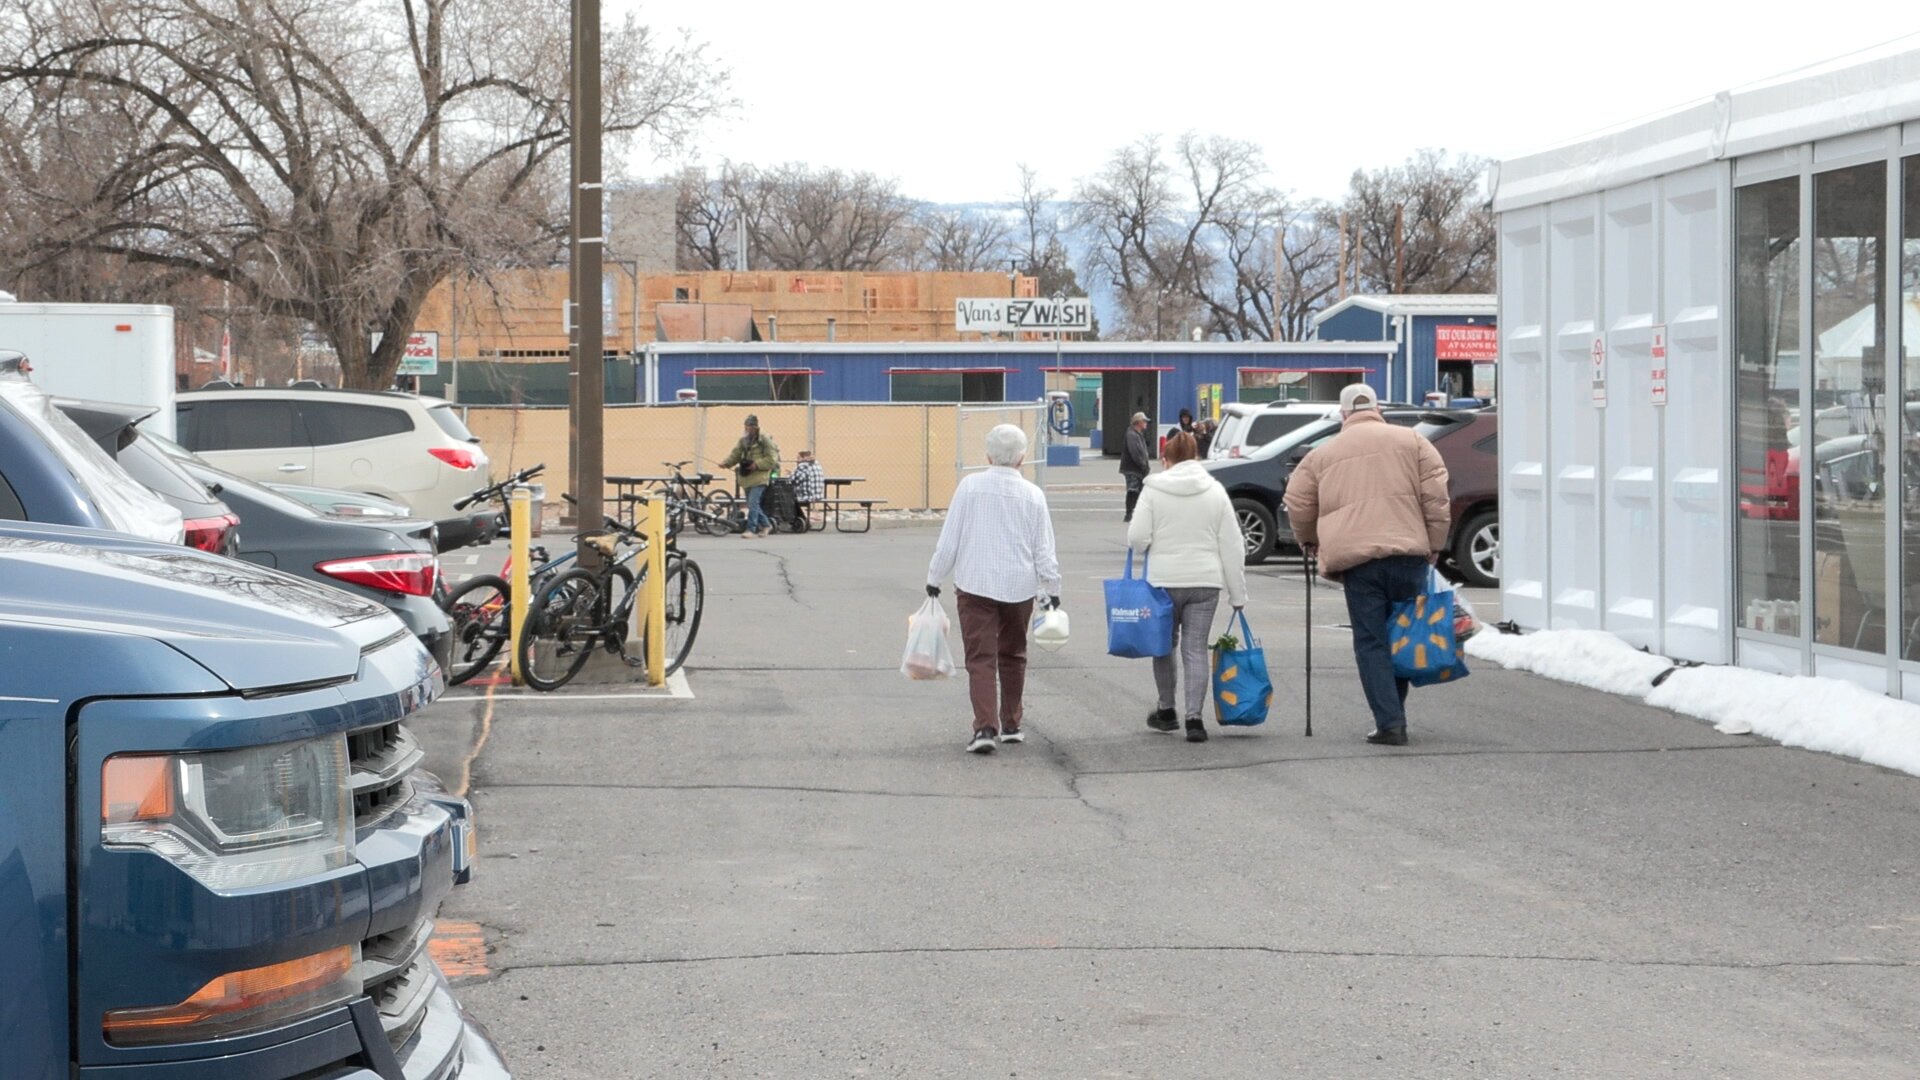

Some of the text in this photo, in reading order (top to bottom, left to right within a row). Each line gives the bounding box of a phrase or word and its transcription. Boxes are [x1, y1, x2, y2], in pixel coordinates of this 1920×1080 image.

[958, 301, 1000, 325] Van's
[1034, 305, 1087, 323] WASH
[1484, 330, 1496, 340] WA
